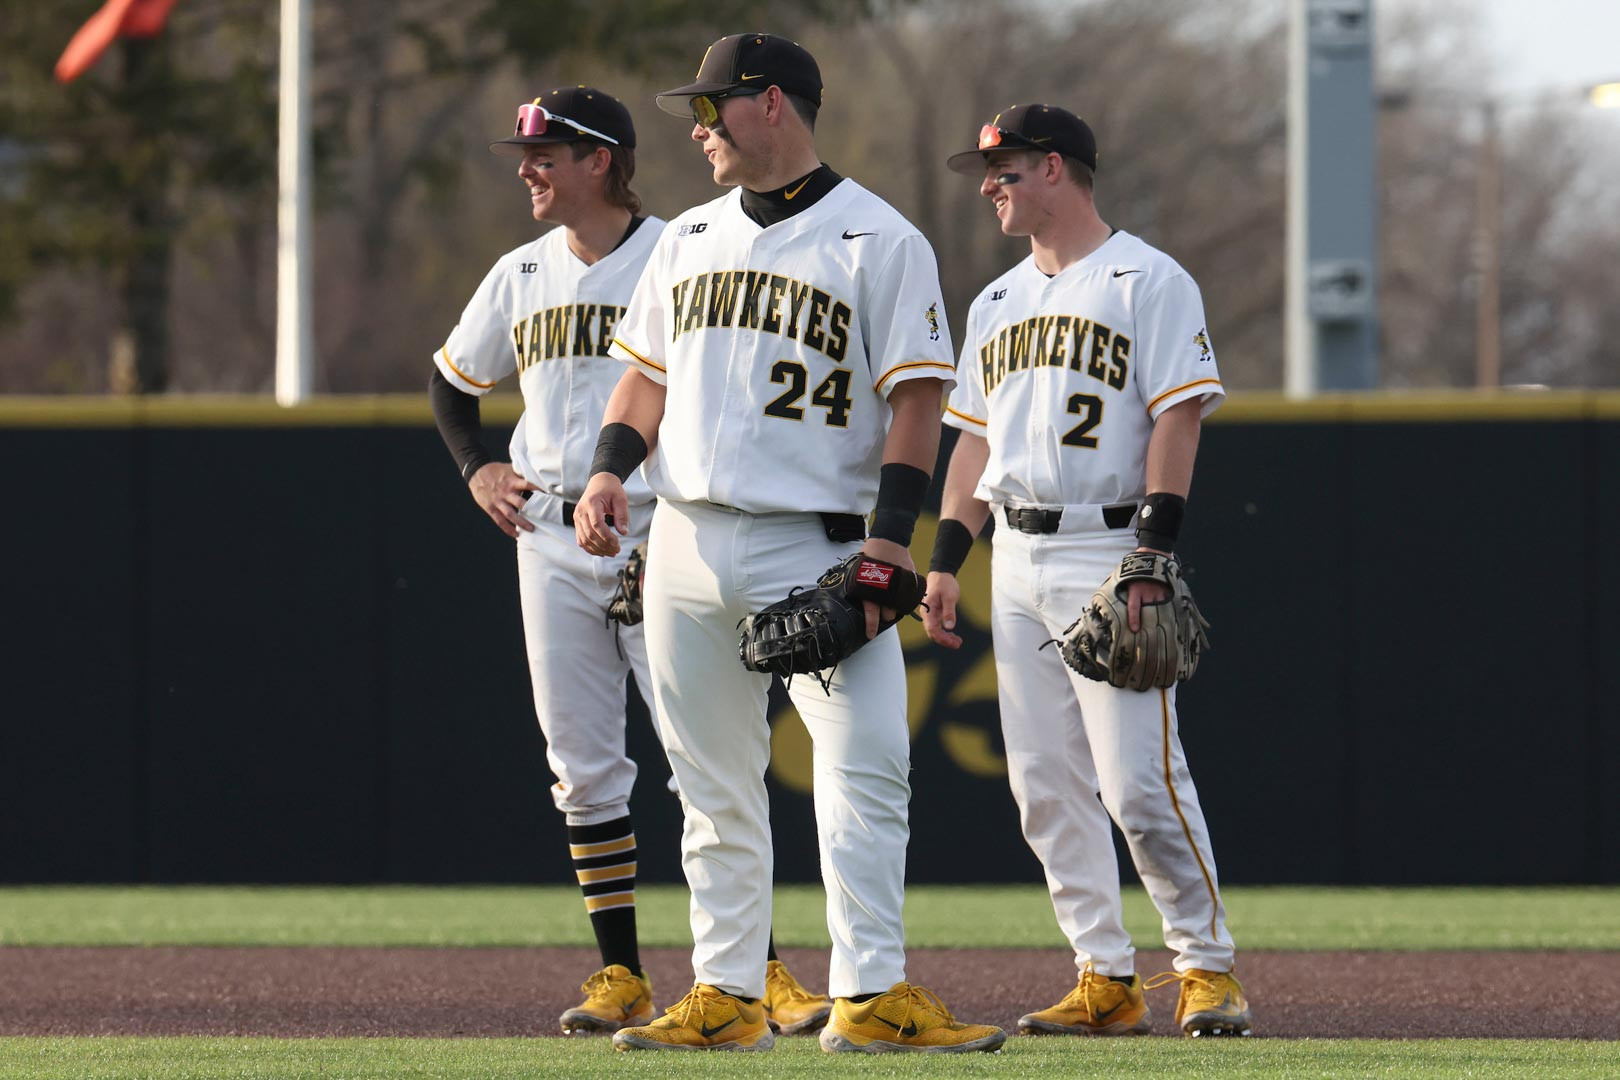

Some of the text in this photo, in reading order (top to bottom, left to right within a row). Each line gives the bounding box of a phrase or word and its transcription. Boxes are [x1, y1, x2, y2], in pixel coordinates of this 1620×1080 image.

[513, 303, 628, 376] HAWKE
[672, 270, 852, 364] HAWKEYES
[981, 315, 1131, 398] HAWKEYES
[763, 360, 853, 428] 24
[1061, 392, 1104, 448] 2
